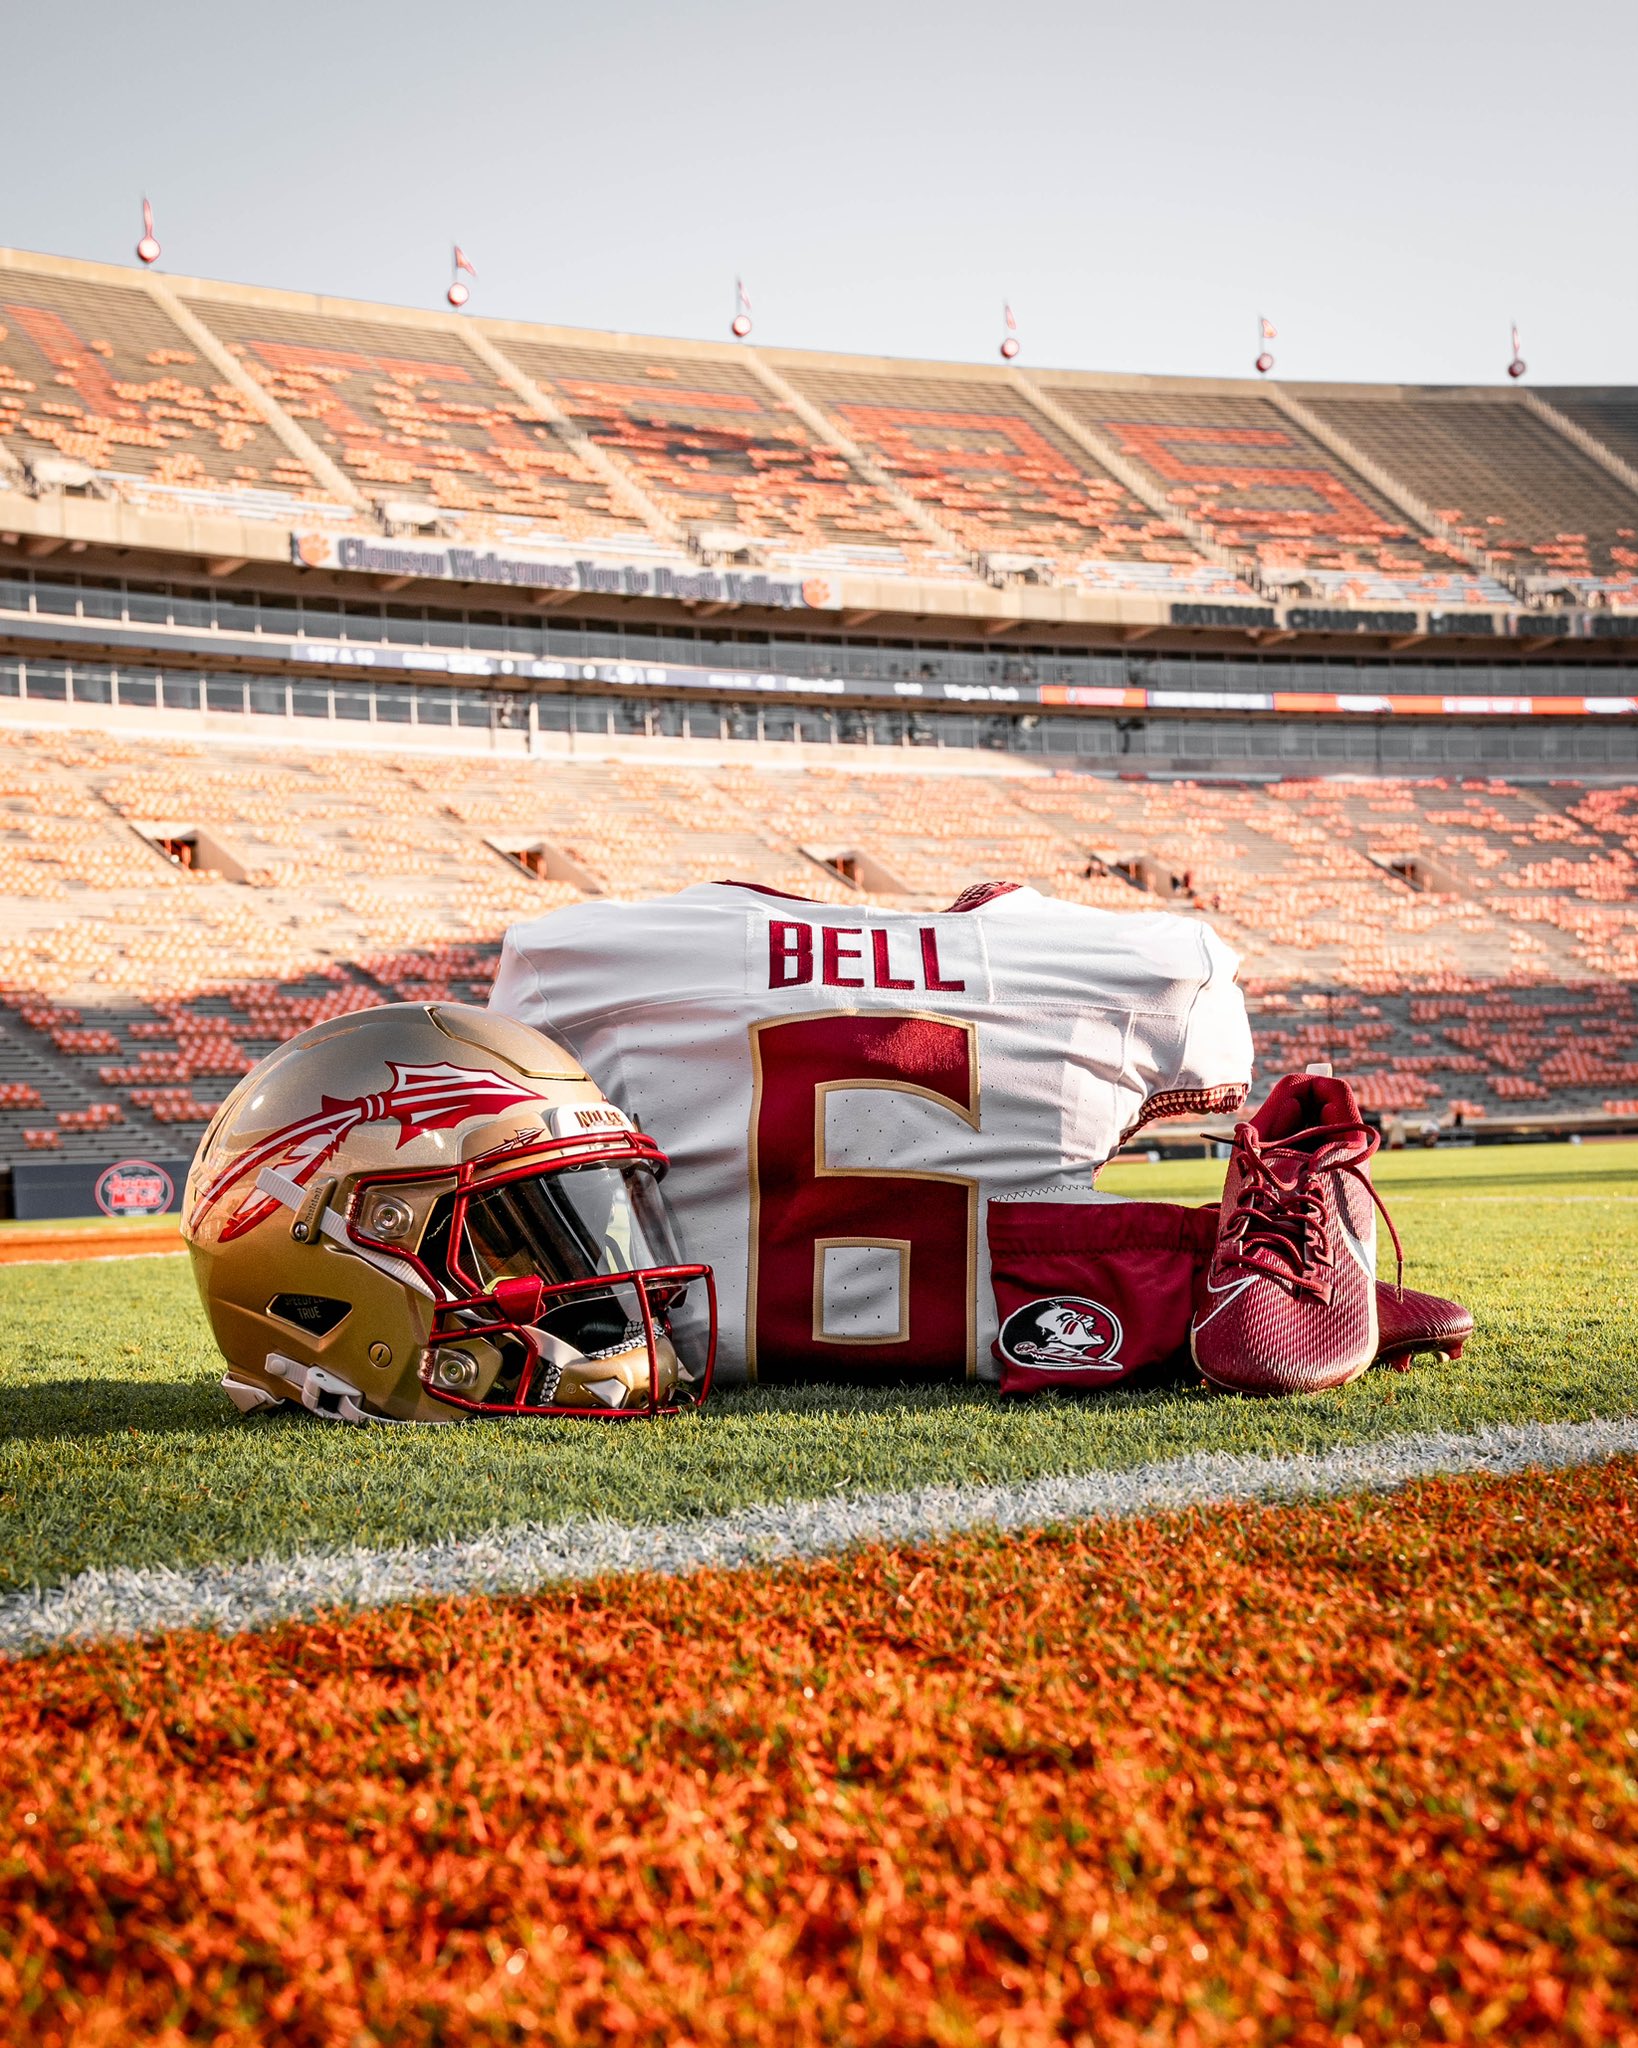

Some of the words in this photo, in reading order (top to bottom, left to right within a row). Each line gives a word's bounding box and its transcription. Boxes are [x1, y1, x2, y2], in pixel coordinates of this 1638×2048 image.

[338, 538, 445, 575] Clemson
[448, 549, 574, 588] Welcomes
[576, 560, 620, 590] You
[624, 566, 650, 592] to
[653, 567, 722, 599] Death
[725, 573, 794, 609] Valley
[769, 919, 965, 992] BELL
[745, 1007, 981, 1384] 6
[296, 1306, 323, 1320] TRUE
